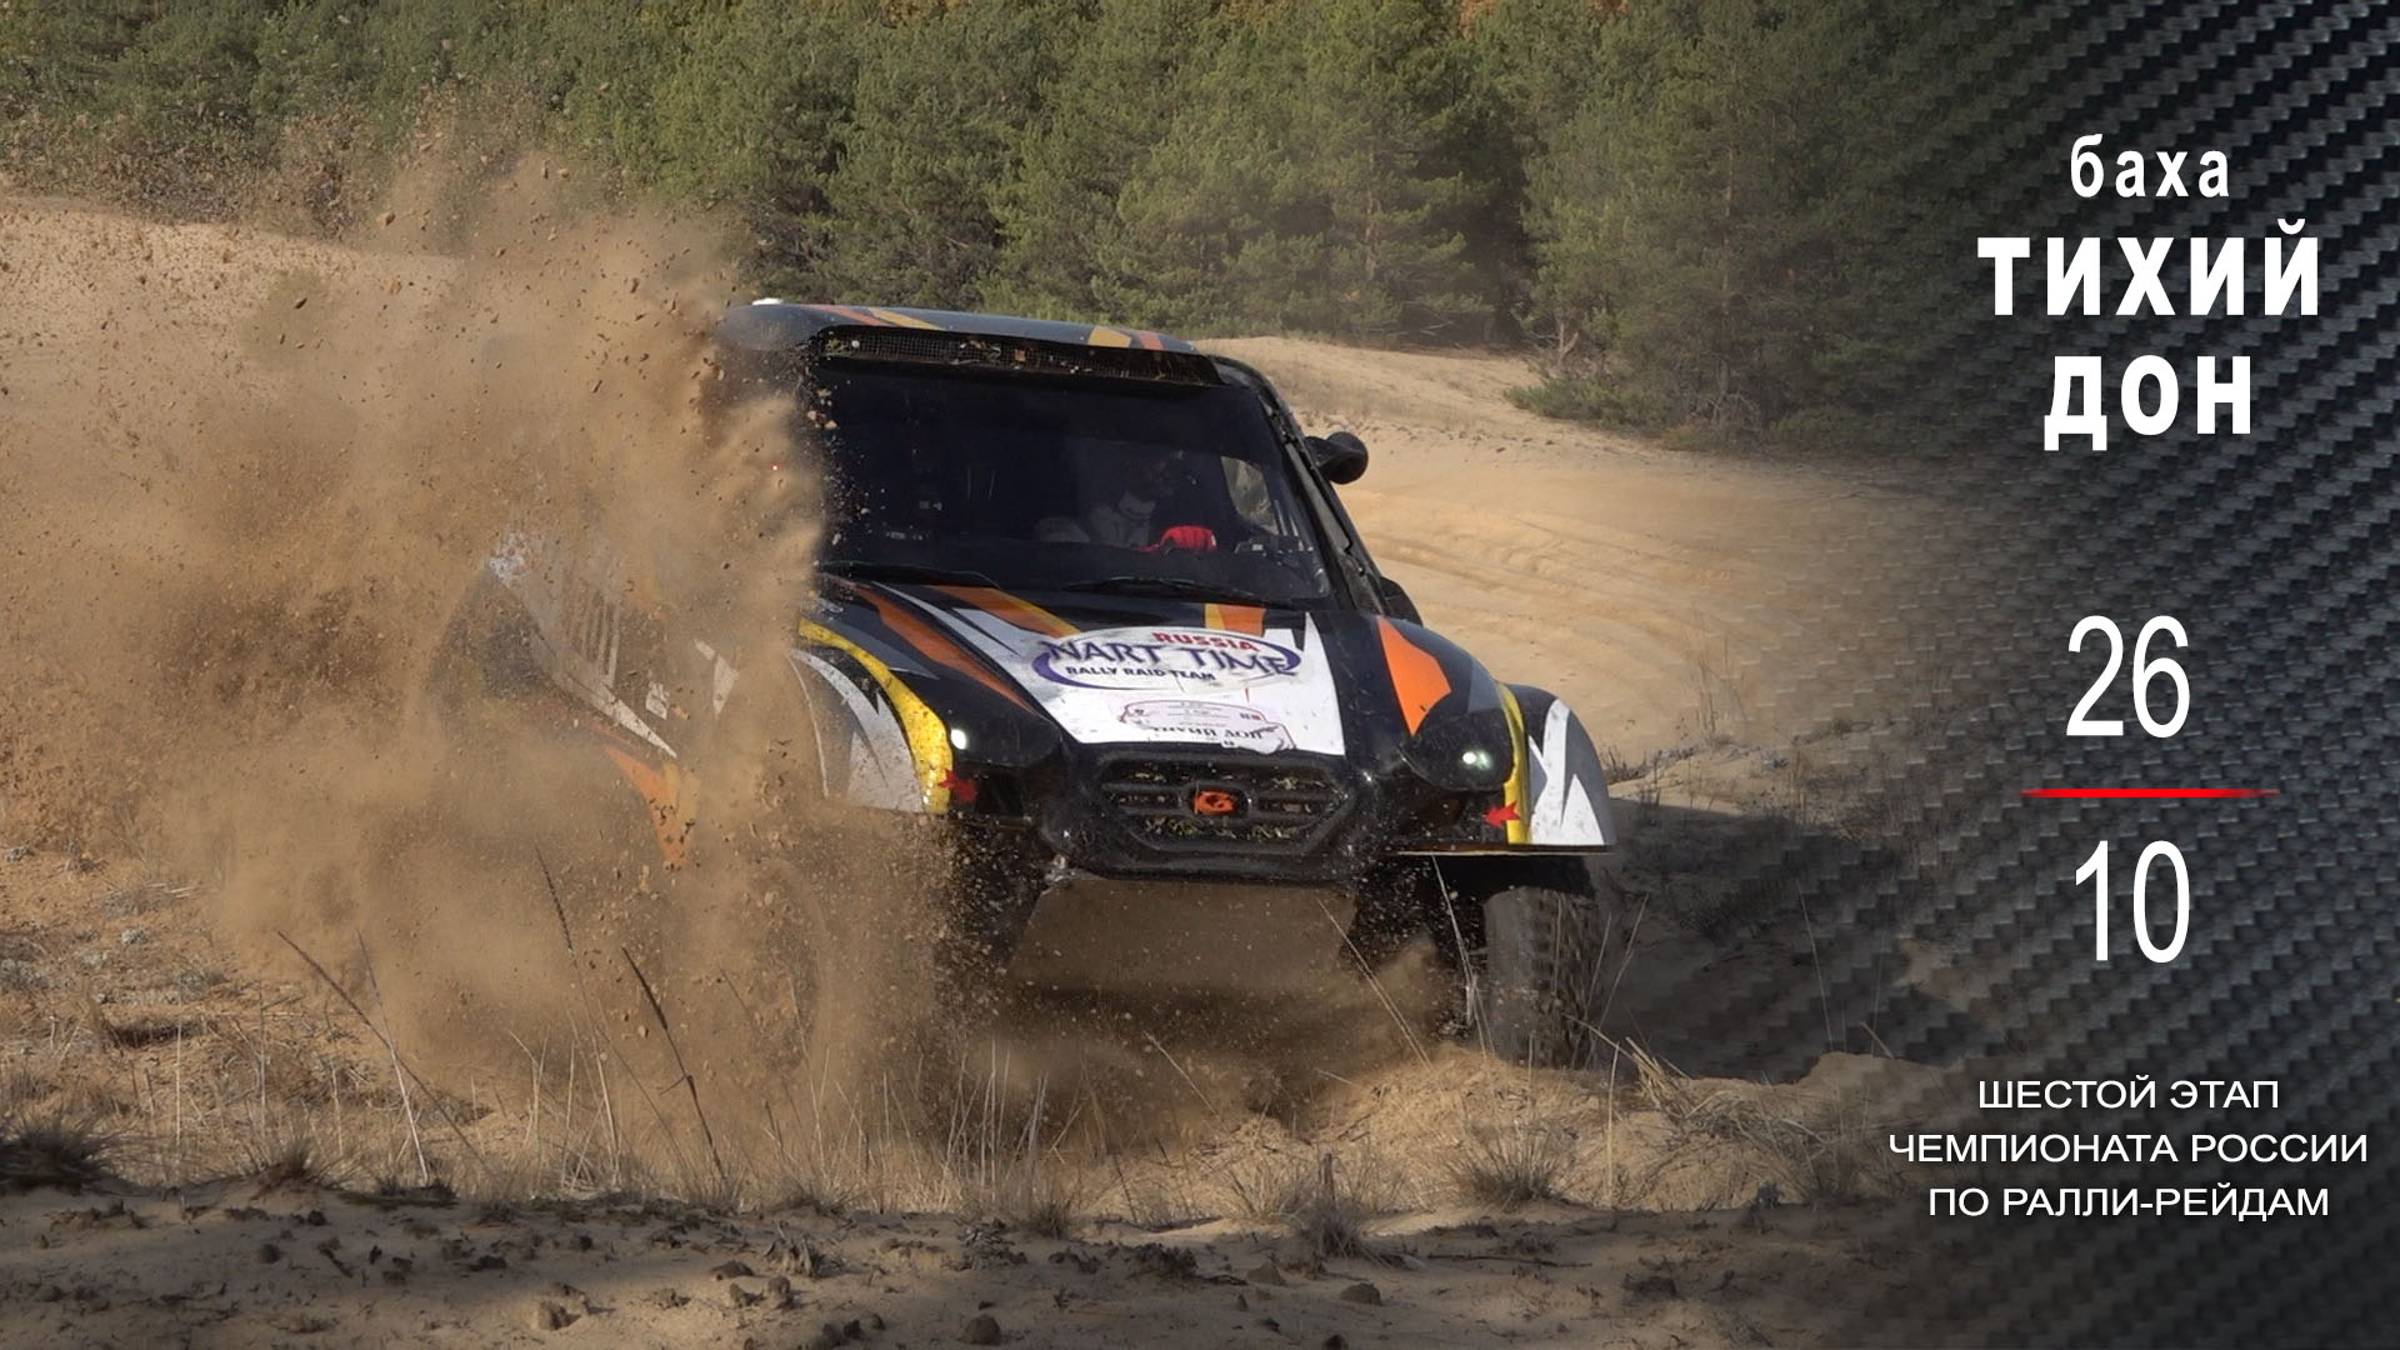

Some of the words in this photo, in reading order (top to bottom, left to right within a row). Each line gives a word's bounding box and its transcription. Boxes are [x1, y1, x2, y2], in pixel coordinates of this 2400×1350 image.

[1152, 631, 1260, 652] RUSSIA
[1038, 640, 1163, 664] NART
[1173, 647, 1295, 676] TIME
[1066, 666, 1117, 676] RALLY
[1123, 667, 1163, 678] RAID
[1170, 669, 1216, 681] TEAM
